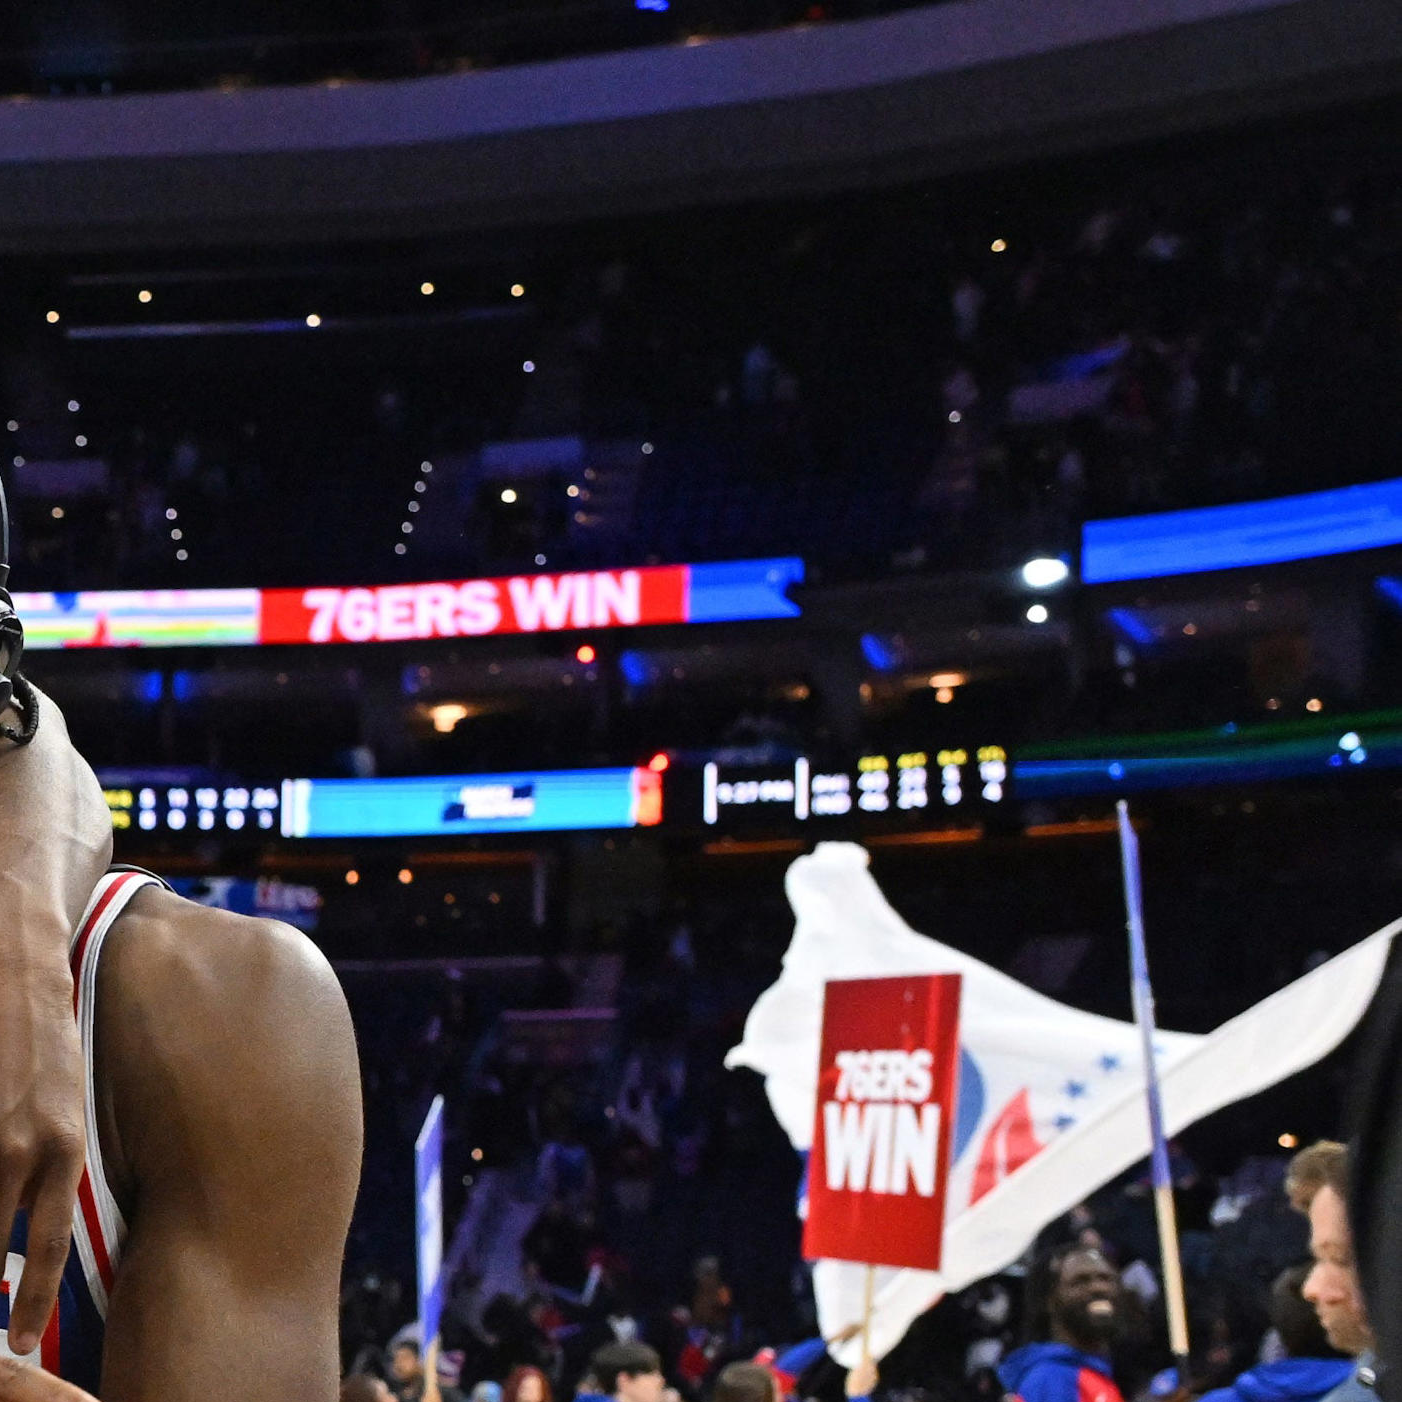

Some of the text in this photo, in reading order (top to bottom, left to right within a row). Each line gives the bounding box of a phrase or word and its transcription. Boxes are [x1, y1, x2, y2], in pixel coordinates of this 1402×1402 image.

[303, 570, 641, 643] 76ERS WIN
[834, 1050, 934, 1103] 76ERS
[823, 1100, 941, 1197] WIN
